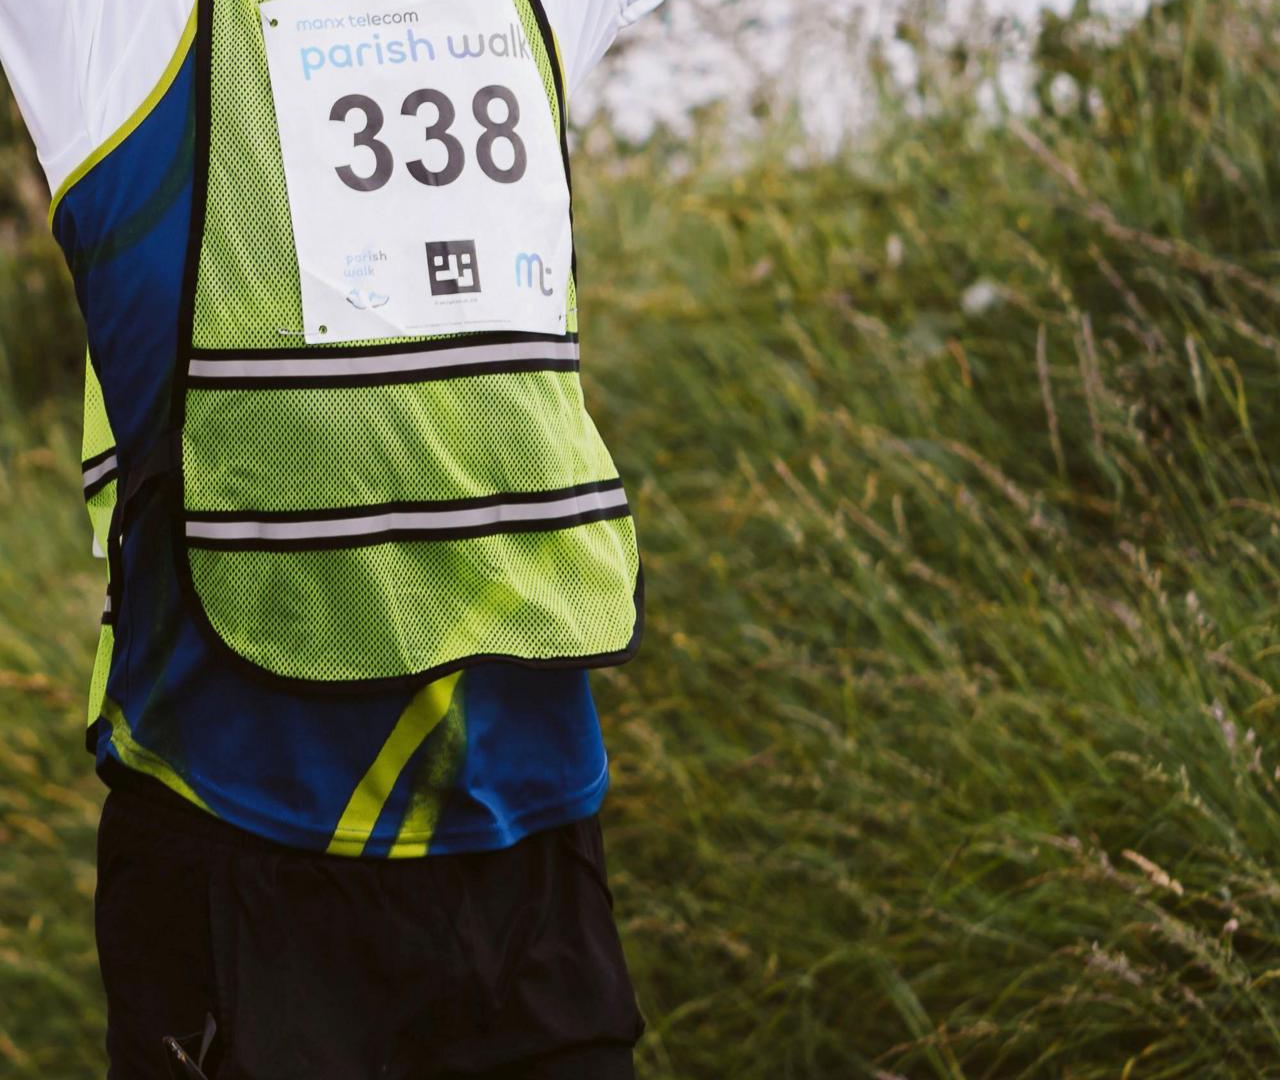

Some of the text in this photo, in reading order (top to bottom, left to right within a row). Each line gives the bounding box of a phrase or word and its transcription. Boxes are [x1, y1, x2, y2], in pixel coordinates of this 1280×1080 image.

[295, 9, 419, 32] manx telecom
[299, 29, 436, 80] parish
[329, 85, 528, 193] 338
[346, 250, 388, 266] parish
[343, 265, 376, 279] walk
